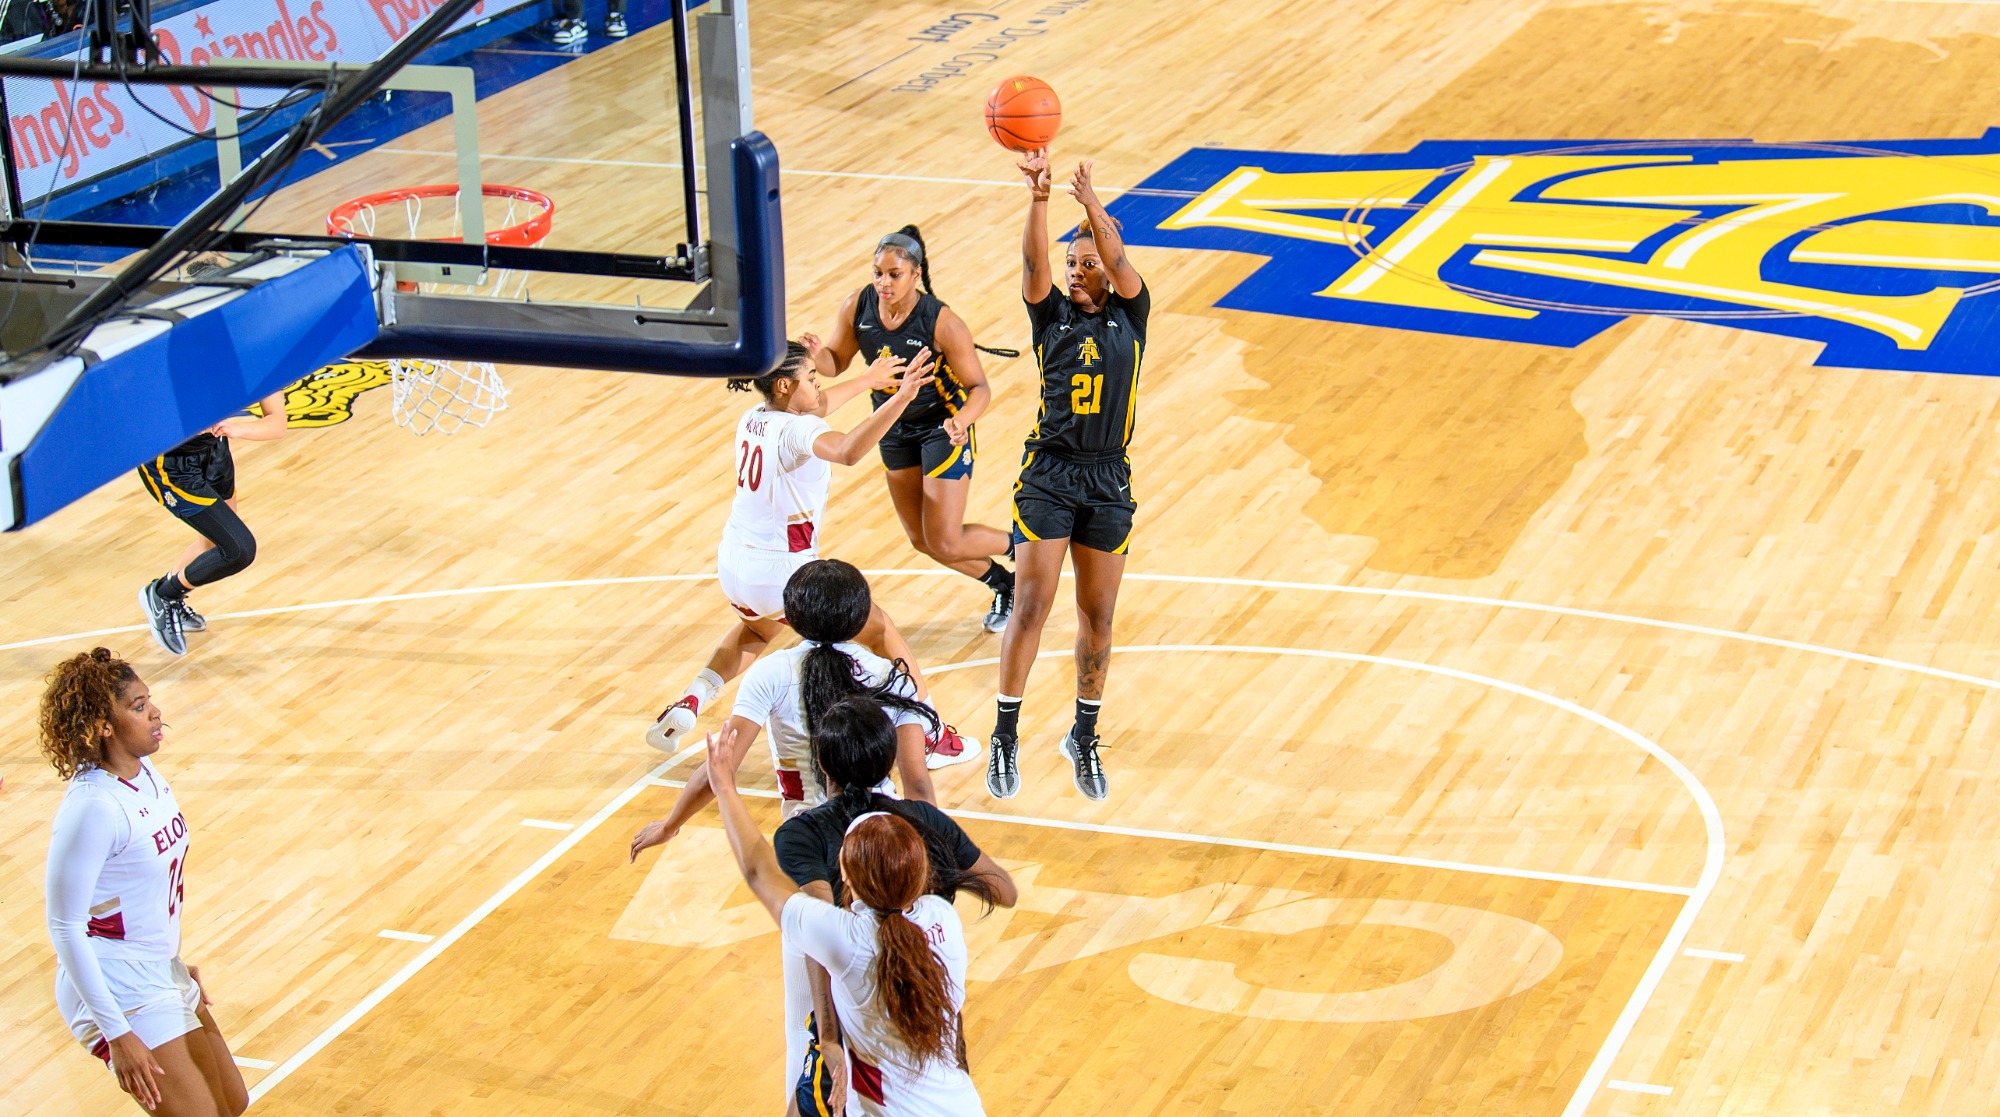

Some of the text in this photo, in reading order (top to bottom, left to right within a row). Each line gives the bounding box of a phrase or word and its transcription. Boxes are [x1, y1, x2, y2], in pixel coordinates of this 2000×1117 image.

[907, 12, 1000, 43] Court
[11, 76, 125, 179] ngles
[906, 338, 922, 347] CAA
[1071, 373, 1104, 415] 21
[737, 440, 763, 492] 20
[168, 844, 189, 918] 24
